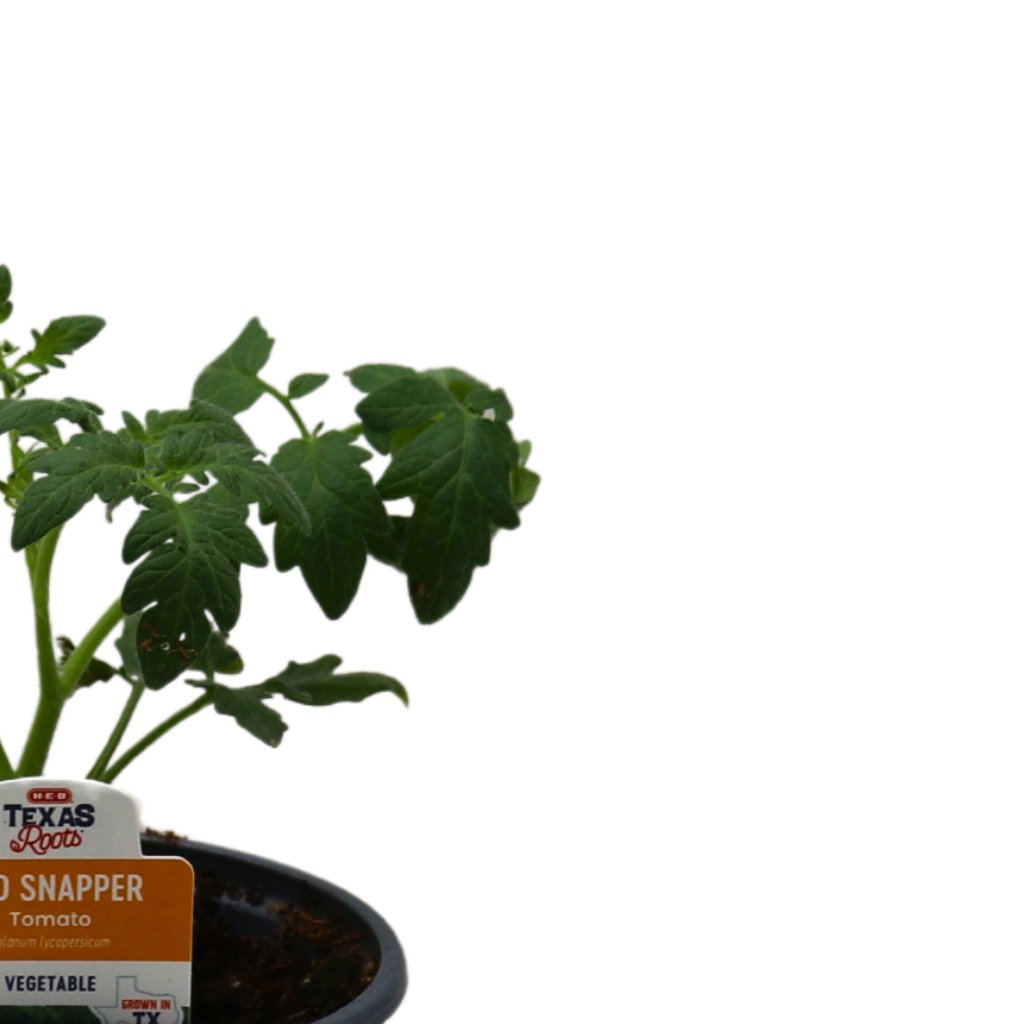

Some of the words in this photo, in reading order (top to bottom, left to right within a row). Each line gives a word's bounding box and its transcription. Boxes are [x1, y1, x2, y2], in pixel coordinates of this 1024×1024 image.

[3, 803, 95, 827] TEXAS
[9, 824, 82, 855] Roots
[20, 874, 144, 901] SNAPPER
[10, 911, 92, 927] Tomato
[39, 935, 111, 950] lycopersicum
[4, 975, 96, 992] VEGETABLE
[121, 999, 158, 1010] GROWN
[160, 1000, 171, 1010] IN
